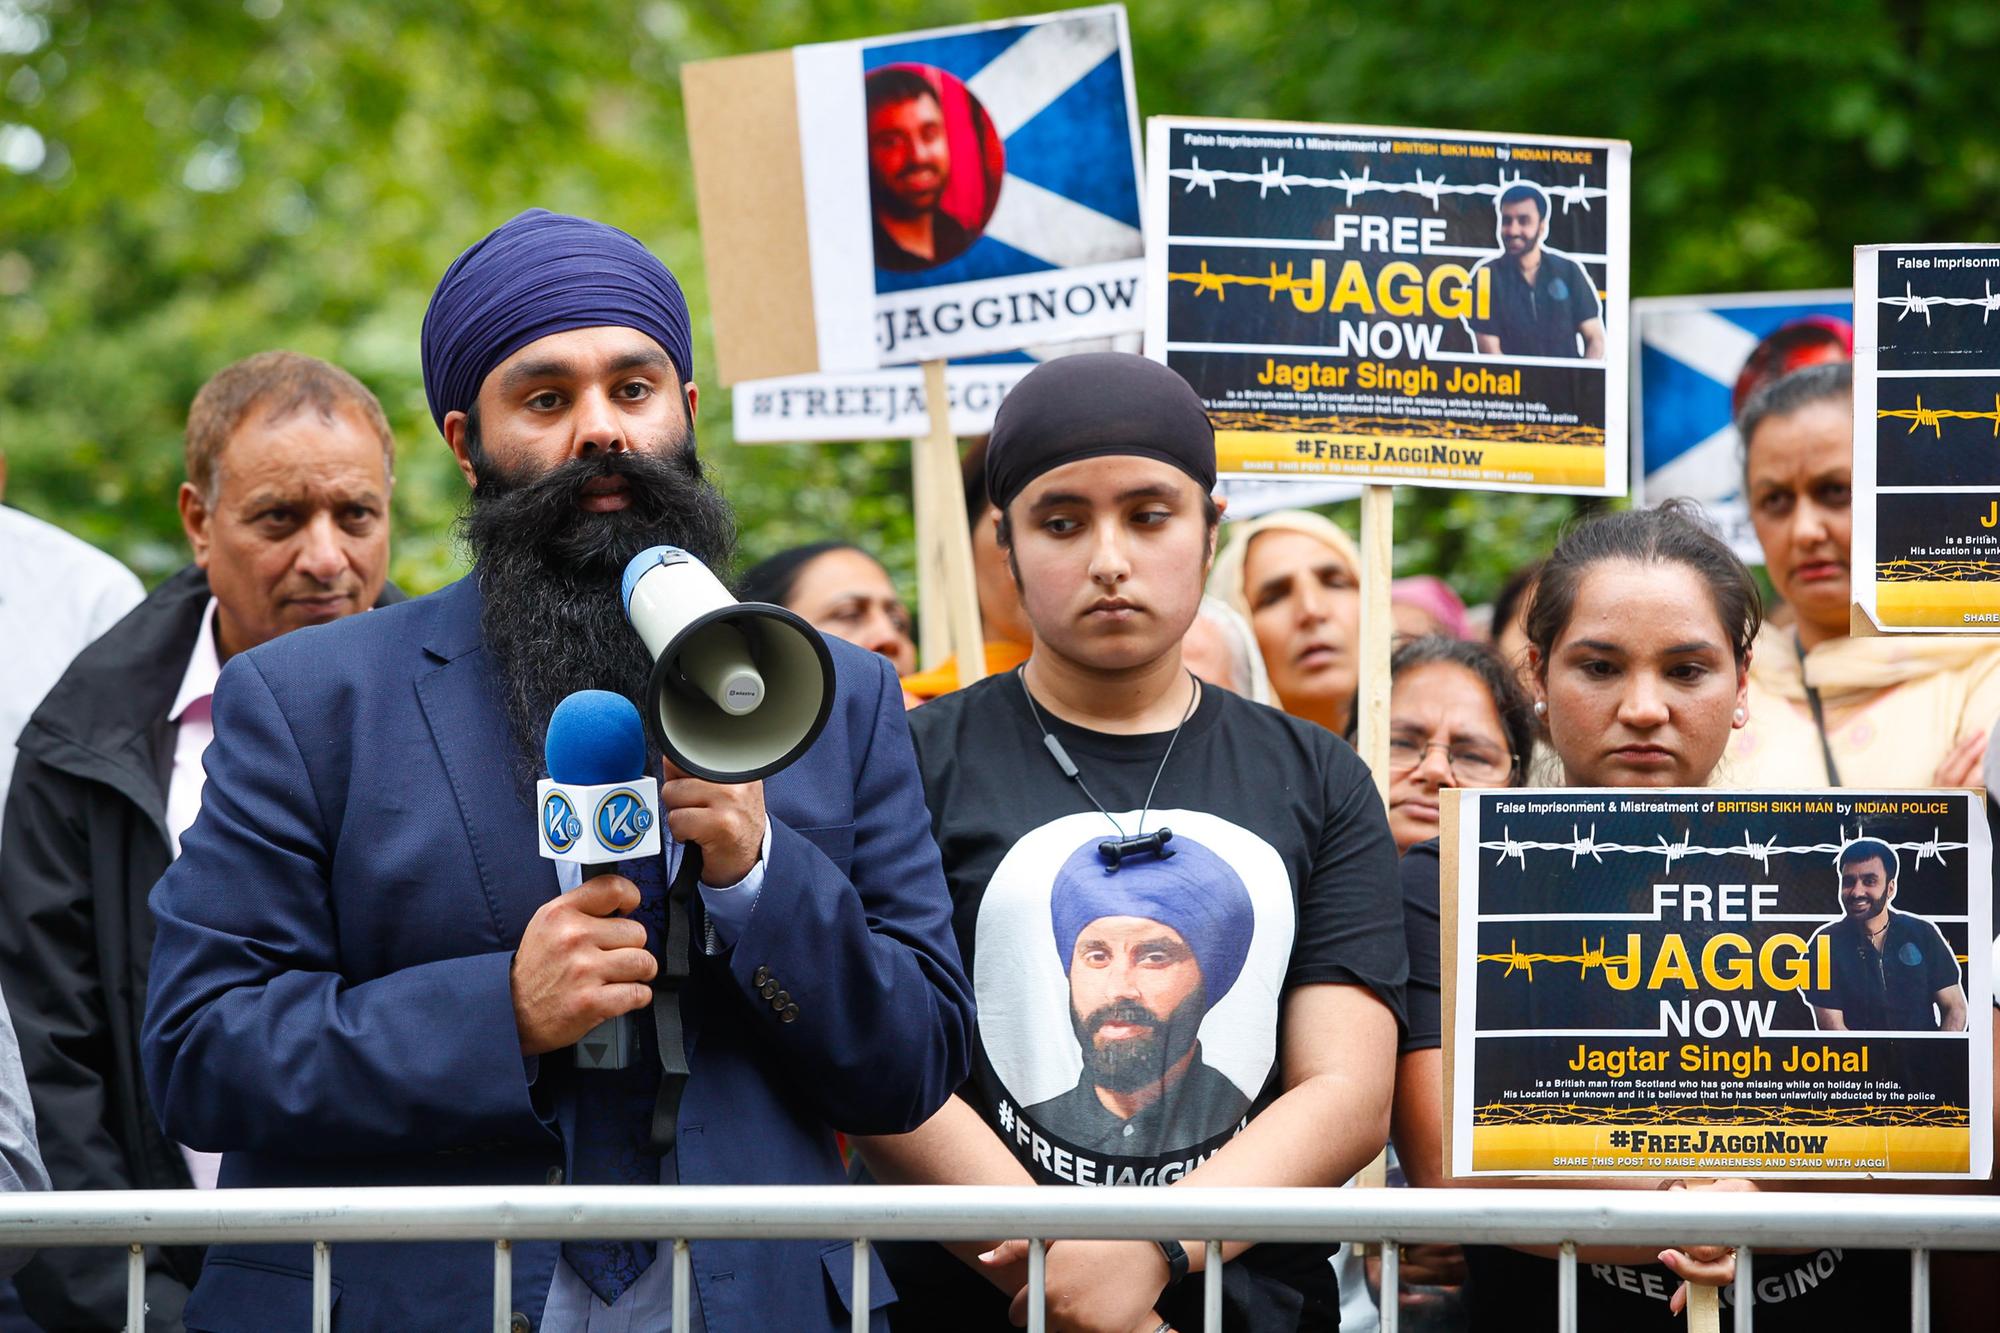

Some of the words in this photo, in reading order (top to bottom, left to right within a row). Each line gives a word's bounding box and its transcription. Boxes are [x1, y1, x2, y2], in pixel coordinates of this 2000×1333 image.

[1334, 214, 1447, 254] FREE
[1897, 257, 1930, 269] False
[1291, 258, 1491, 320] JAGGI
[875, 278, 1139, 351] JAGGINOW
[1339, 321, 1443, 360] NOW
[1257, 360, 1349, 391] Jagtar
[1357, 363, 1437, 398] Singh
[1446, 368, 1521, 395] Johal
[1910, 547, 1926, 555] His
[1928, 547, 1970, 555] Location
[1973, 547, 1981, 555] is
[1945, 536, 1954, 544] is
[1965, 535, 1997, 544] British
[1963, 613, 1999, 622] SHARE
[1495, 802, 1525, 812] False
[1528, 802, 1605, 815] Imprisonment
[1607, 802, 1616, 812] &
[1620, 802, 1698, 812] Mistreatment
[1701, 802, 1714, 812] of
[1716, 802, 1767, 813] BRITISH
[1770, 802, 1800, 813] SIKH
[1804, 802, 1832, 813] MAN
[1835, 802, 1850, 816] by
[1853, 802, 1897, 813] INDIAN
[1900, 802, 1947, 813] POLICE
[1653, 884, 1779, 922] FREE
[1605, 933, 1831, 992] JAGGI
[1659, 999, 1777, 1038] NOW
[1569, 1043, 1670, 1078] Jagtar
[1680, 1044, 1771, 1079] Singh
[1781, 1045, 1869, 1073] Johal
[1503, 1089, 1517, 1098] His
[1519, 1089, 1558, 1098] Location
[1561, 1090, 1570, 1098] is
[1572, 1090, 1615, 1099] unknown
[1617, 1090, 1635, 1099] and
[1637, 1090, 1644, 1099] it
[1647, 1090, 1655, 1099] is
[1658, 1091, 1697, 1099] believed
[1700, 1091, 1718, 1099] that
[1720, 1091, 1732, 1100] he
[1735, 1091, 1752, 1100] has
[1754, 1091, 1777, 1100] been
[1780, 1092, 1827, 1102] unlawfully
[1830, 1092, 1873, 1101] abducted
[1876, 1092, 1886, 1103] by
[1889, 1093, 1904, 1101] the
[1907, 1093, 1935, 1103] police
[1535, 1079, 1543, 1087] is
[1554, 1079, 1585, 1087] British
[1610, 1079, 1632, 1088] from
[1635, 1079, 1676, 1088] Scotland
[1678, 1080, 1697, 1088] who
[1700, 1080, 1718, 1088] has
[1720, 1082, 1743, 1091] gone
[1745, 1080, 1782, 1091] missing
[1785, 1081, 1809, 1089] while
[1826, 1081, 1860, 1091] holiday
[1863, 1081, 1872, 1089] in
[1874, 1081, 1901, 1090] India.
[1552, 1156, 1588, 1166] SHARE
[1591, 1156, 1614, 1166] THIS
[1617, 1156, 1644, 1166] POST
[1647, 1156, 1661, 1166] TO
[1664, 1157, 1695, 1166] RAISE
[1698, 1157, 1762, 1166] AWARENESS
[1764, 1157, 1786, 1166] AND
[1789, 1157, 1822, 1166] STAND
[1825, 1157, 1850, 1166] WITH
[1854, 1157, 1885, 1166] JAGGI
